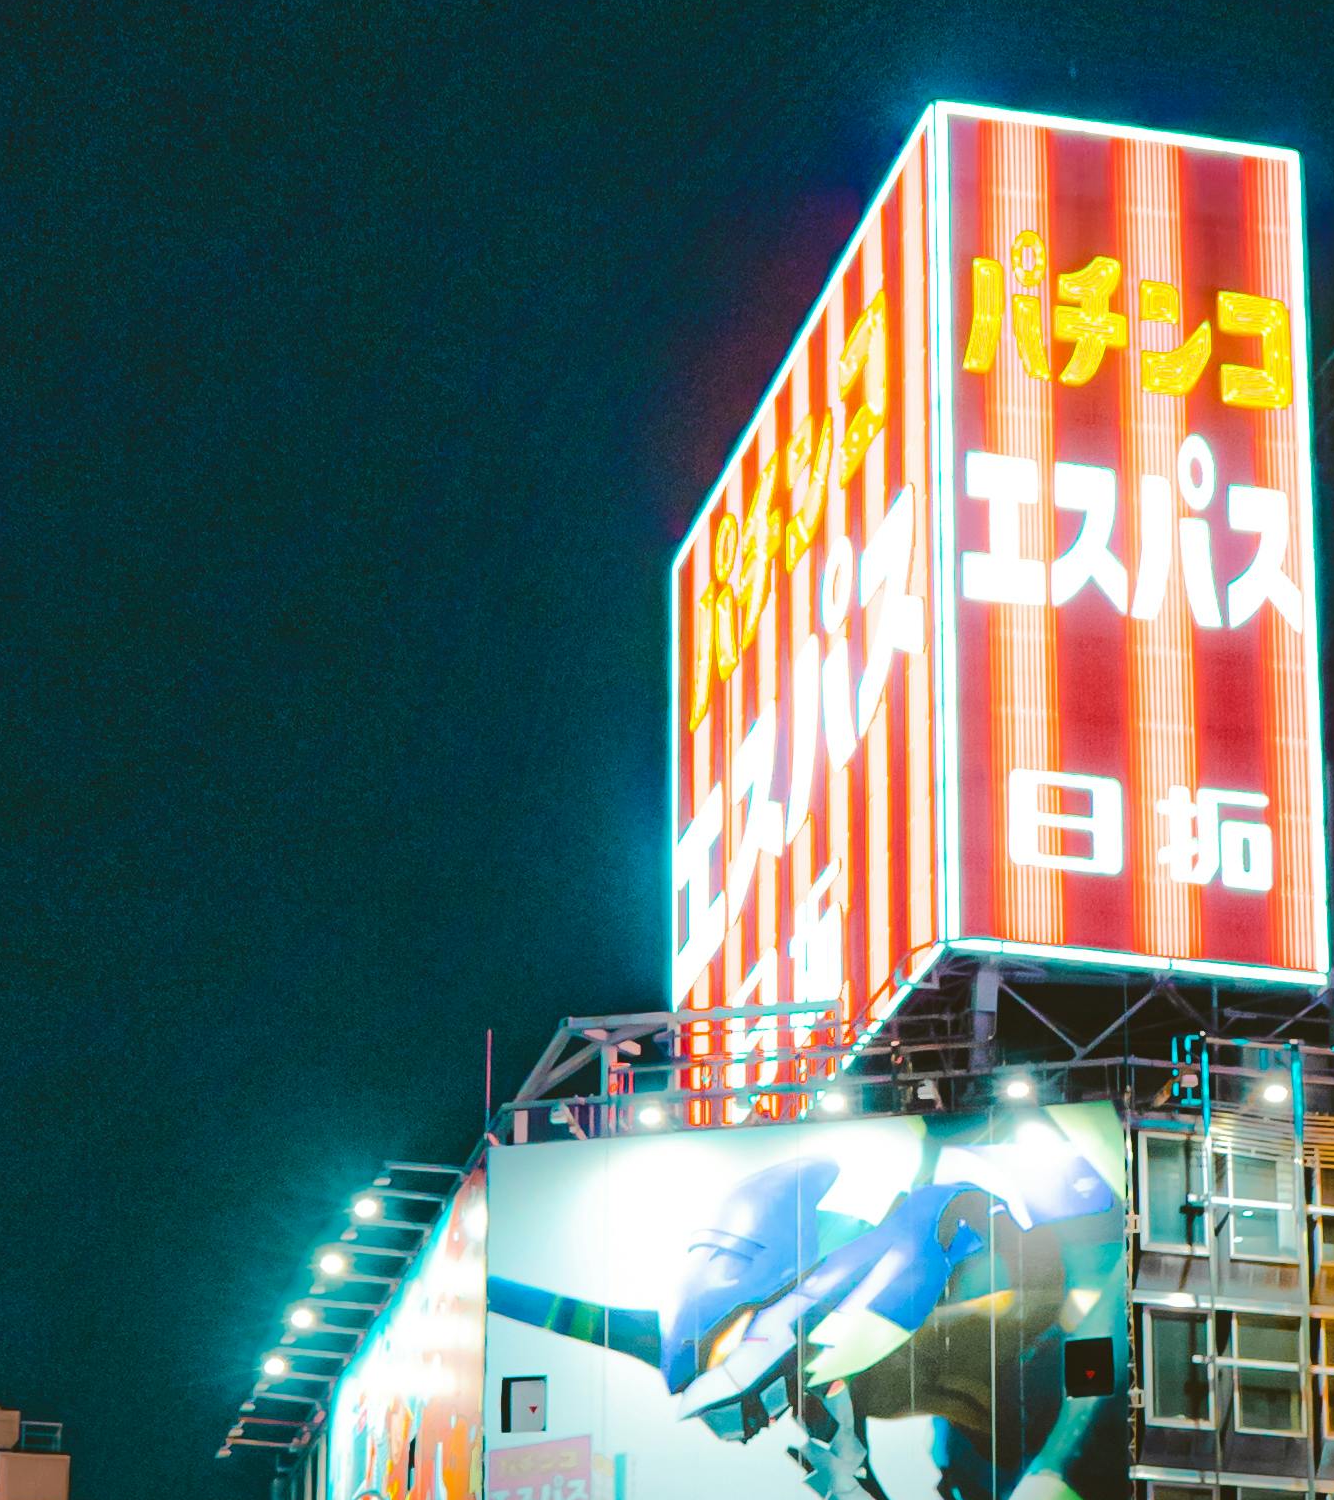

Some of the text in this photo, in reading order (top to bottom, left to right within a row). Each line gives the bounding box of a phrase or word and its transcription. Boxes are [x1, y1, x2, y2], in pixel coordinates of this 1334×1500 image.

[962, 229, 1291, 410] パチンコ
[690, 288, 886, 732] パチンコ
[962, 433, 1303, 631] エスパス
[673, 483, 924, 1010] エスパス
[1008, 767, 1273, 892] 日拓
